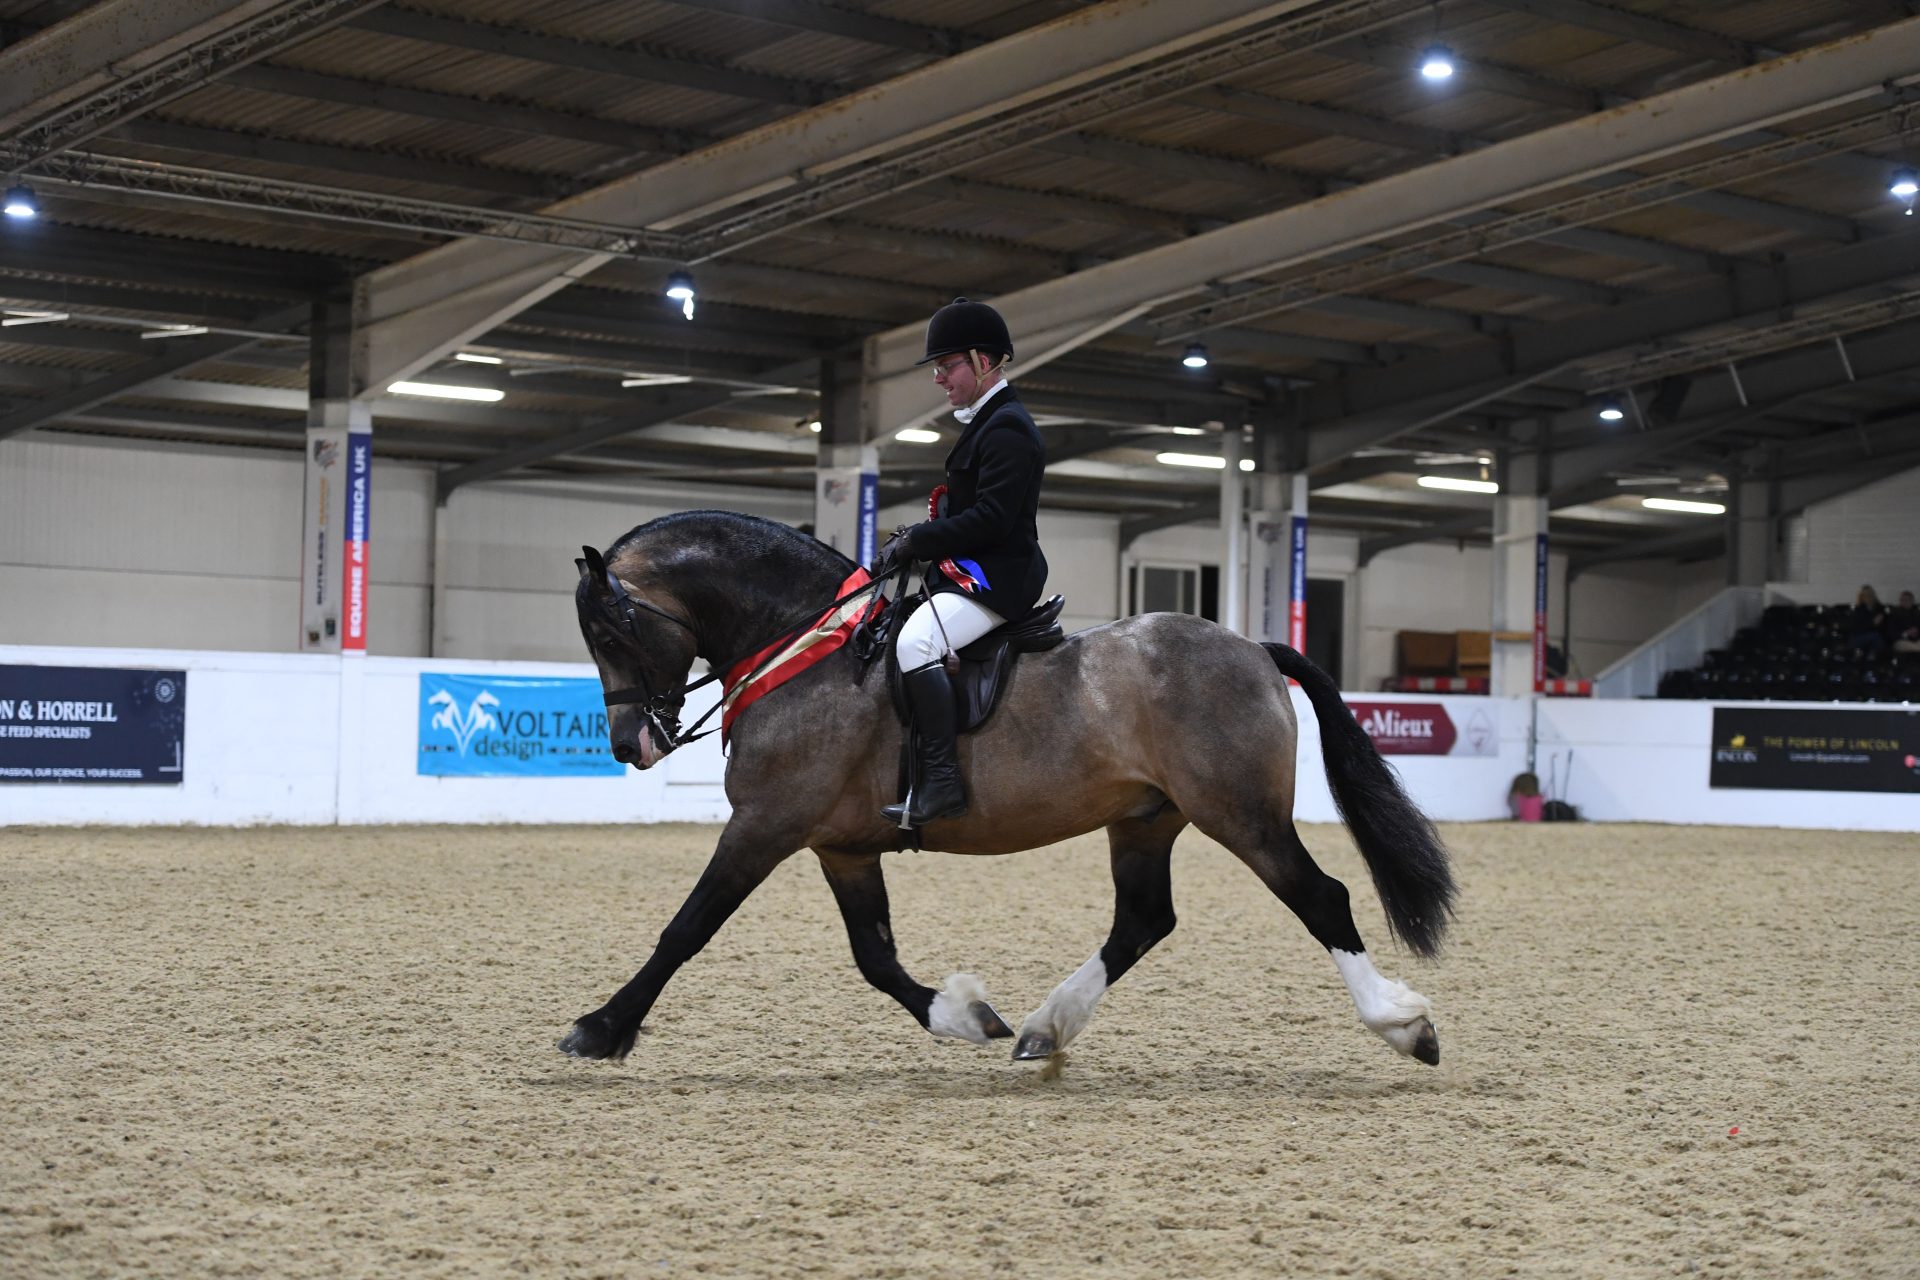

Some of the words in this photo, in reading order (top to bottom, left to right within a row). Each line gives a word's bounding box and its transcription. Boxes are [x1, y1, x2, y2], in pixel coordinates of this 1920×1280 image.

[354, 446, 366, 473] UK
[864, 485, 874, 510] UK
[352, 477, 365, 563] AMERICA
[862, 513, 874, 571] ERICA
[349, 566, 363, 638] EQUINE
[0, 699, 15, 720] N
[18, 700, 34, 721] &
[37, 700, 118, 722] HORRELL
[1350, 709, 1434, 738] eMieux
[8, 725, 33, 738] FEED
[33, 725, 92, 739] SPECIALISTS
[496, 711, 609, 739] VOLTAIR
[474, 734, 544, 761] design
[1850, 738, 1900, 751] LINCOLN
